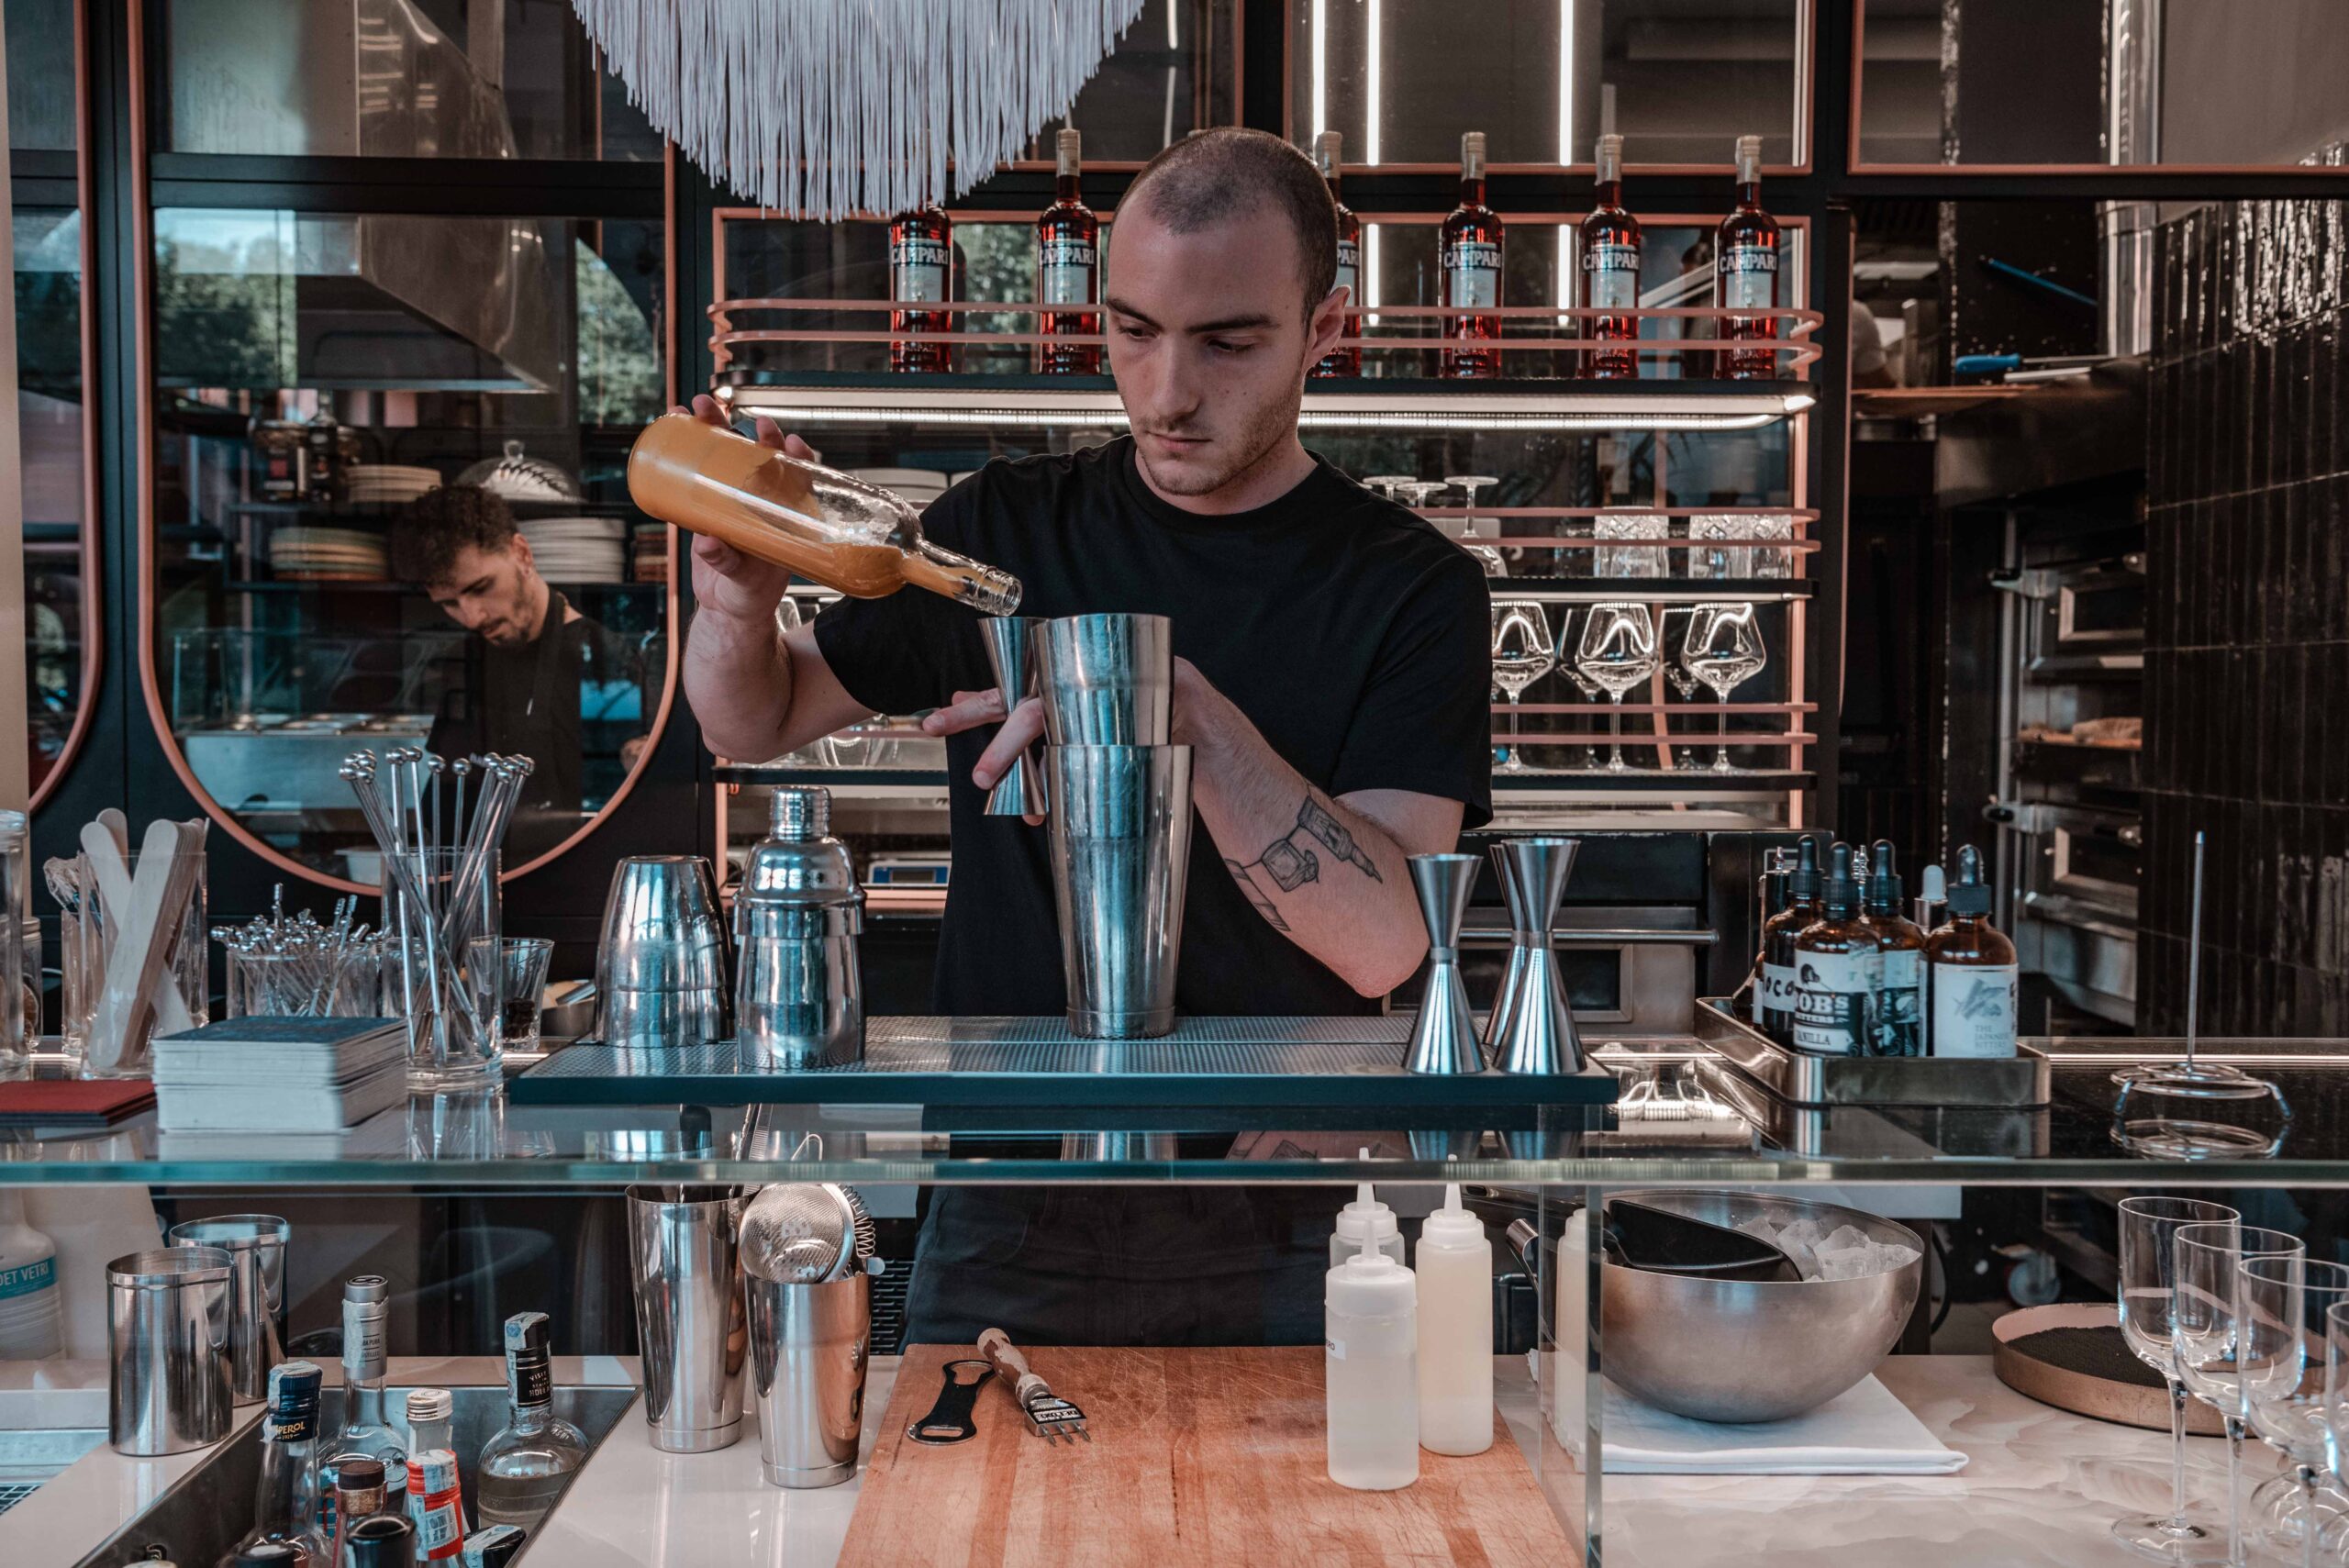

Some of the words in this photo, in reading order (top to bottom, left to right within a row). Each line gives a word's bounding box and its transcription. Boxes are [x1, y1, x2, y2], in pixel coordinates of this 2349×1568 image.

[892, 246, 949, 265] CAMPARI
[1039, 247, 1095, 265] CAMPARI
[1443, 249, 1502, 268] CAMPARI
[1583, 251, 1640, 271] CAMPARI
[1719, 253, 1777, 272] CAMPARI
[1797, 992, 1850, 1013] OB'S
[1796, 1029, 1831, 1046] ANILLA
[21, 1262, 50, 1282] VETRI
[529, 1370, 547, 1382] VISIT
